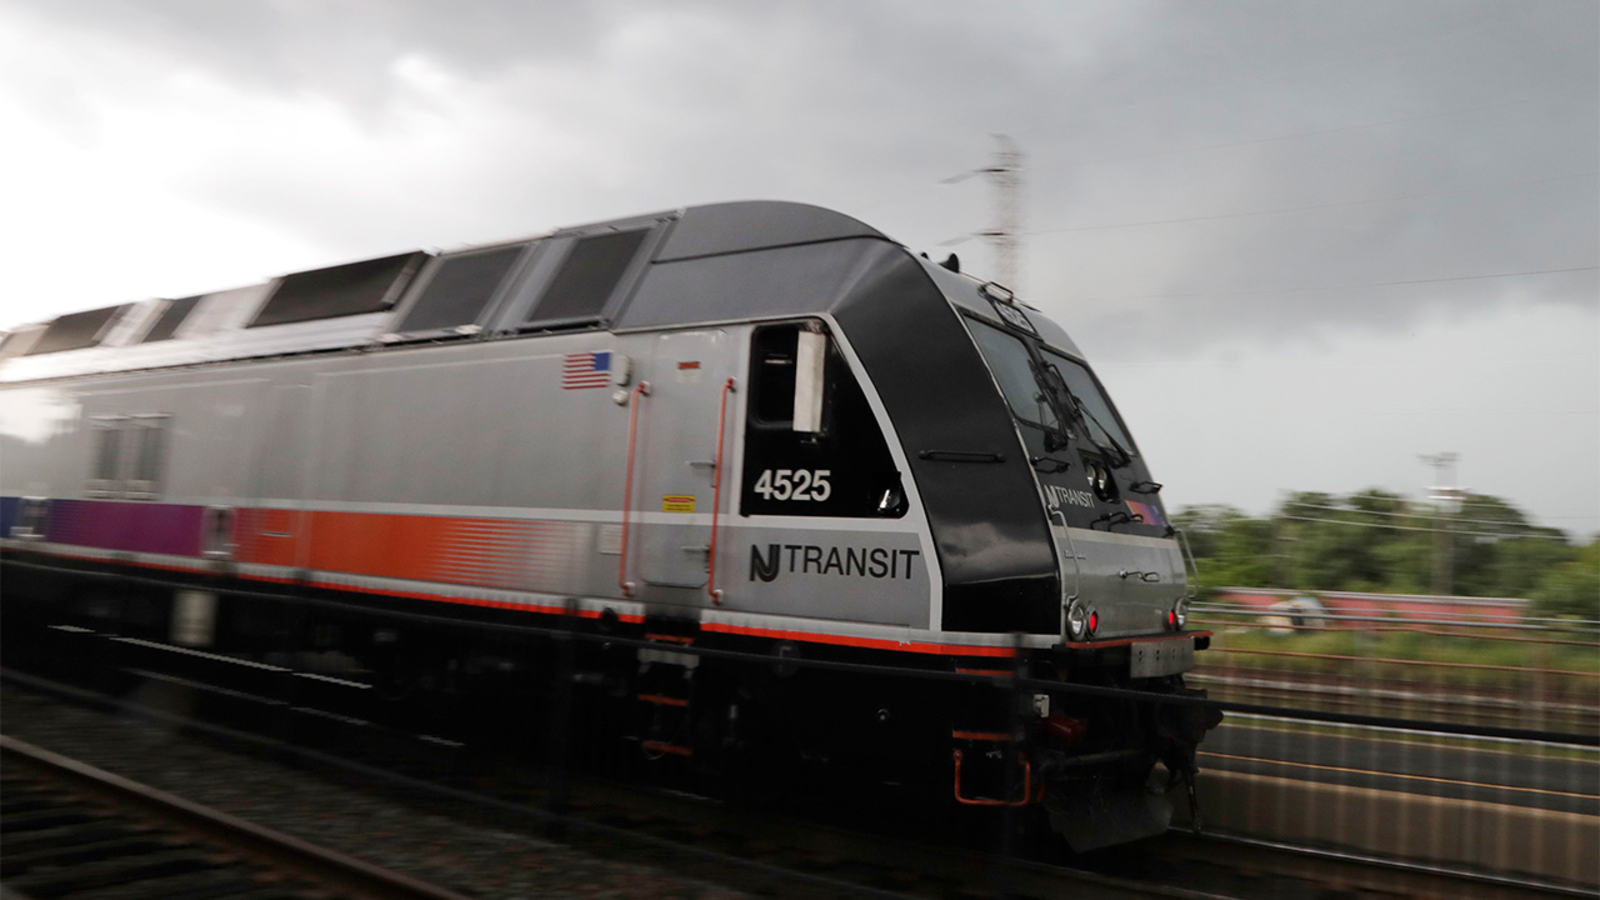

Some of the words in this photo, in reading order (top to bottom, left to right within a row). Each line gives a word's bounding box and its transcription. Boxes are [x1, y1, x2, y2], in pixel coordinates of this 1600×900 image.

[754, 469, 832, 501] 4525
[1056, 487, 1095, 508] TRANSIT
[785, 545, 920, 579] TRANSIT
